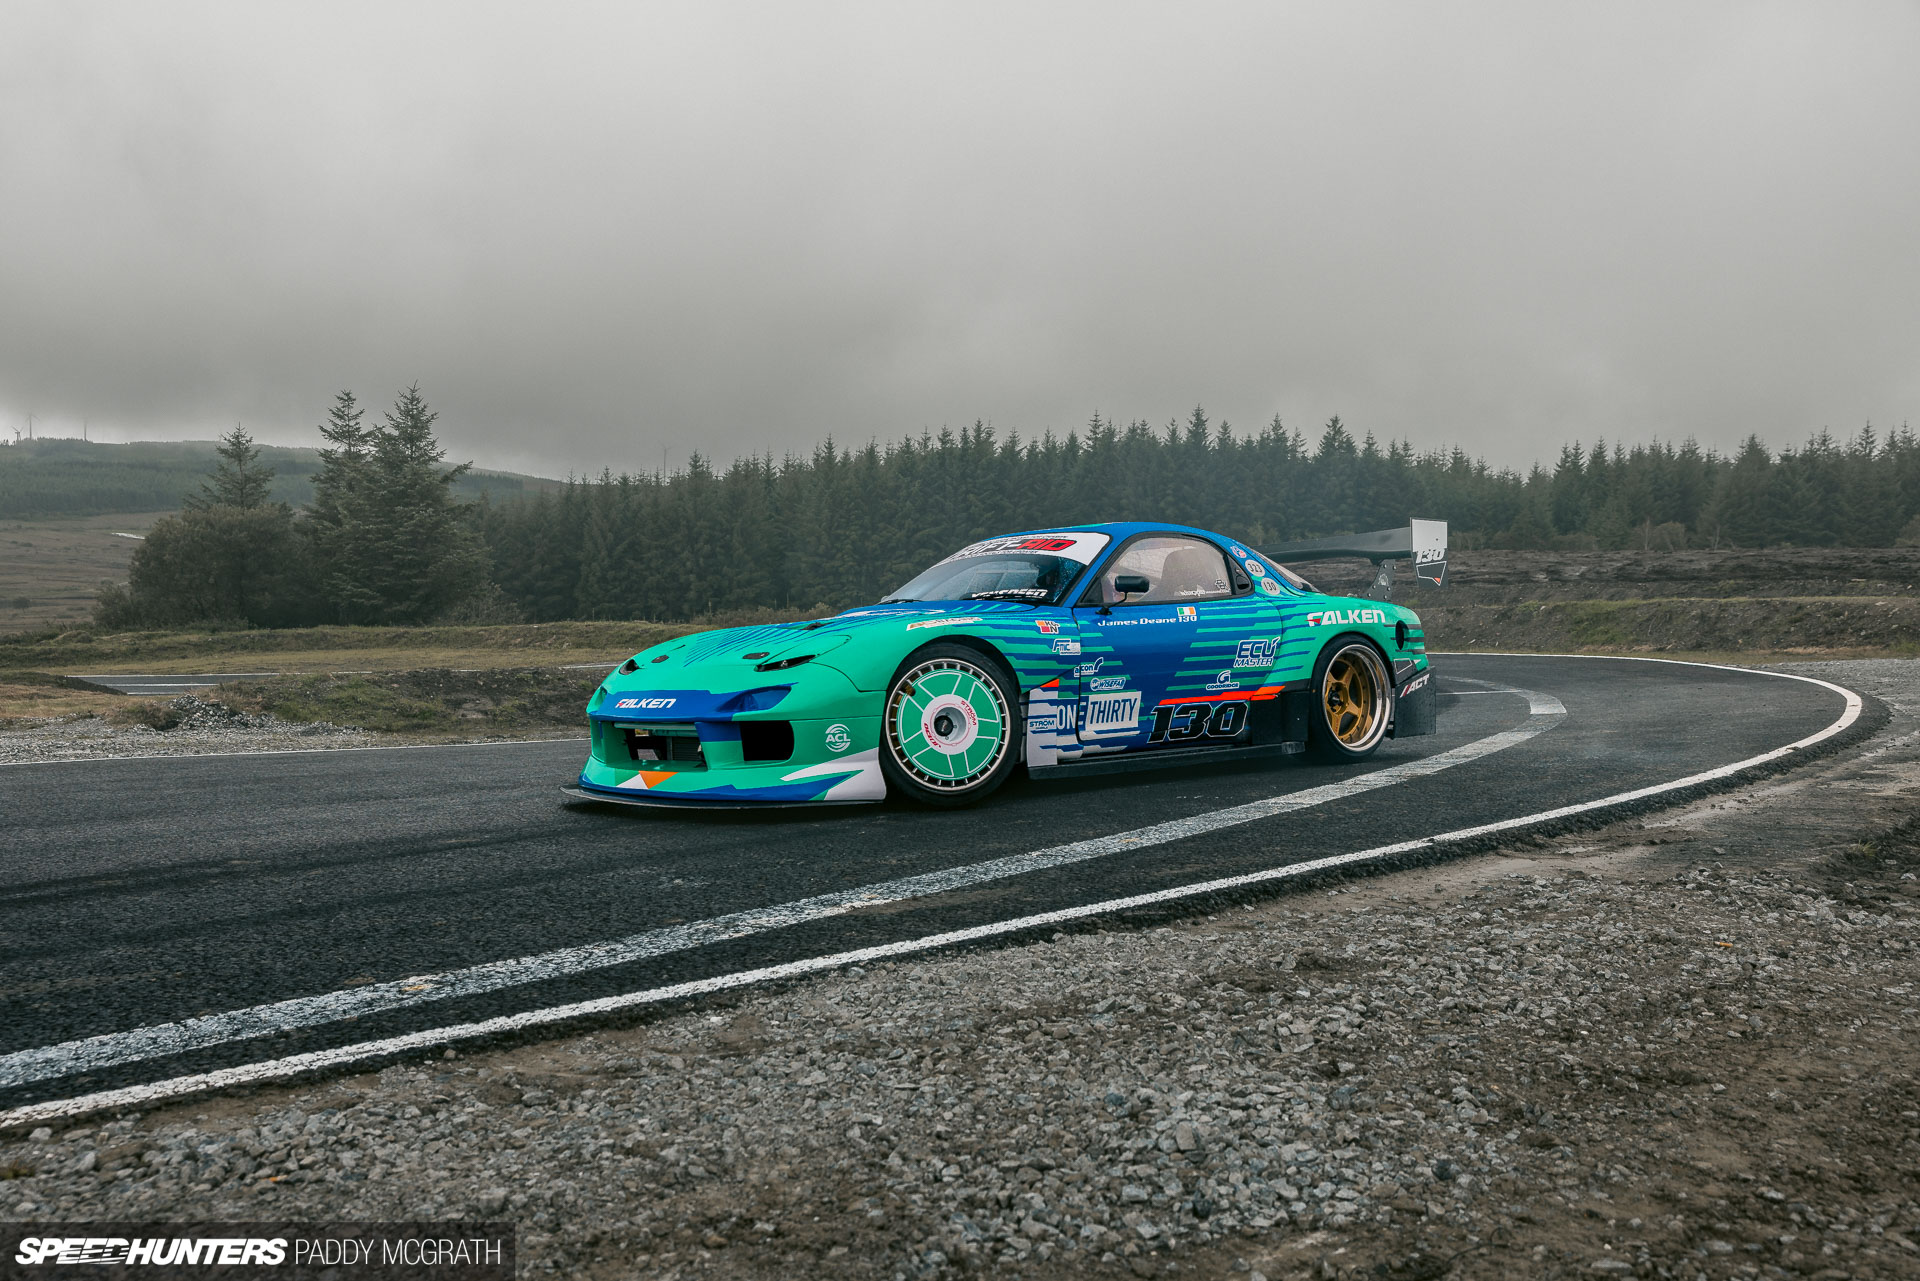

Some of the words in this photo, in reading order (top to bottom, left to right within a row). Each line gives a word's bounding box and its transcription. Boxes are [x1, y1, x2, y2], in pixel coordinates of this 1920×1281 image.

[1416, 549, 1445, 563] 130
[1263, 581, 1277, 591] 130
[1178, 615, 1197, 623] 130
[1306, 609, 1386, 627] FALKEN
[1236, 636, 1281, 658] ECU
[1233, 656, 1274, 668] MASTER
[1074, 664, 1095, 674] acon
[1206, 682, 1239, 690] GOODRIDGE
[615, 698, 677, 708] FALKEN
[1056, 701, 1087, 730] ONE
[1089, 698, 1139, 725] THIRTY
[1147, 700, 1249, 744] 130
[825, 733, 851, 743] ACL
